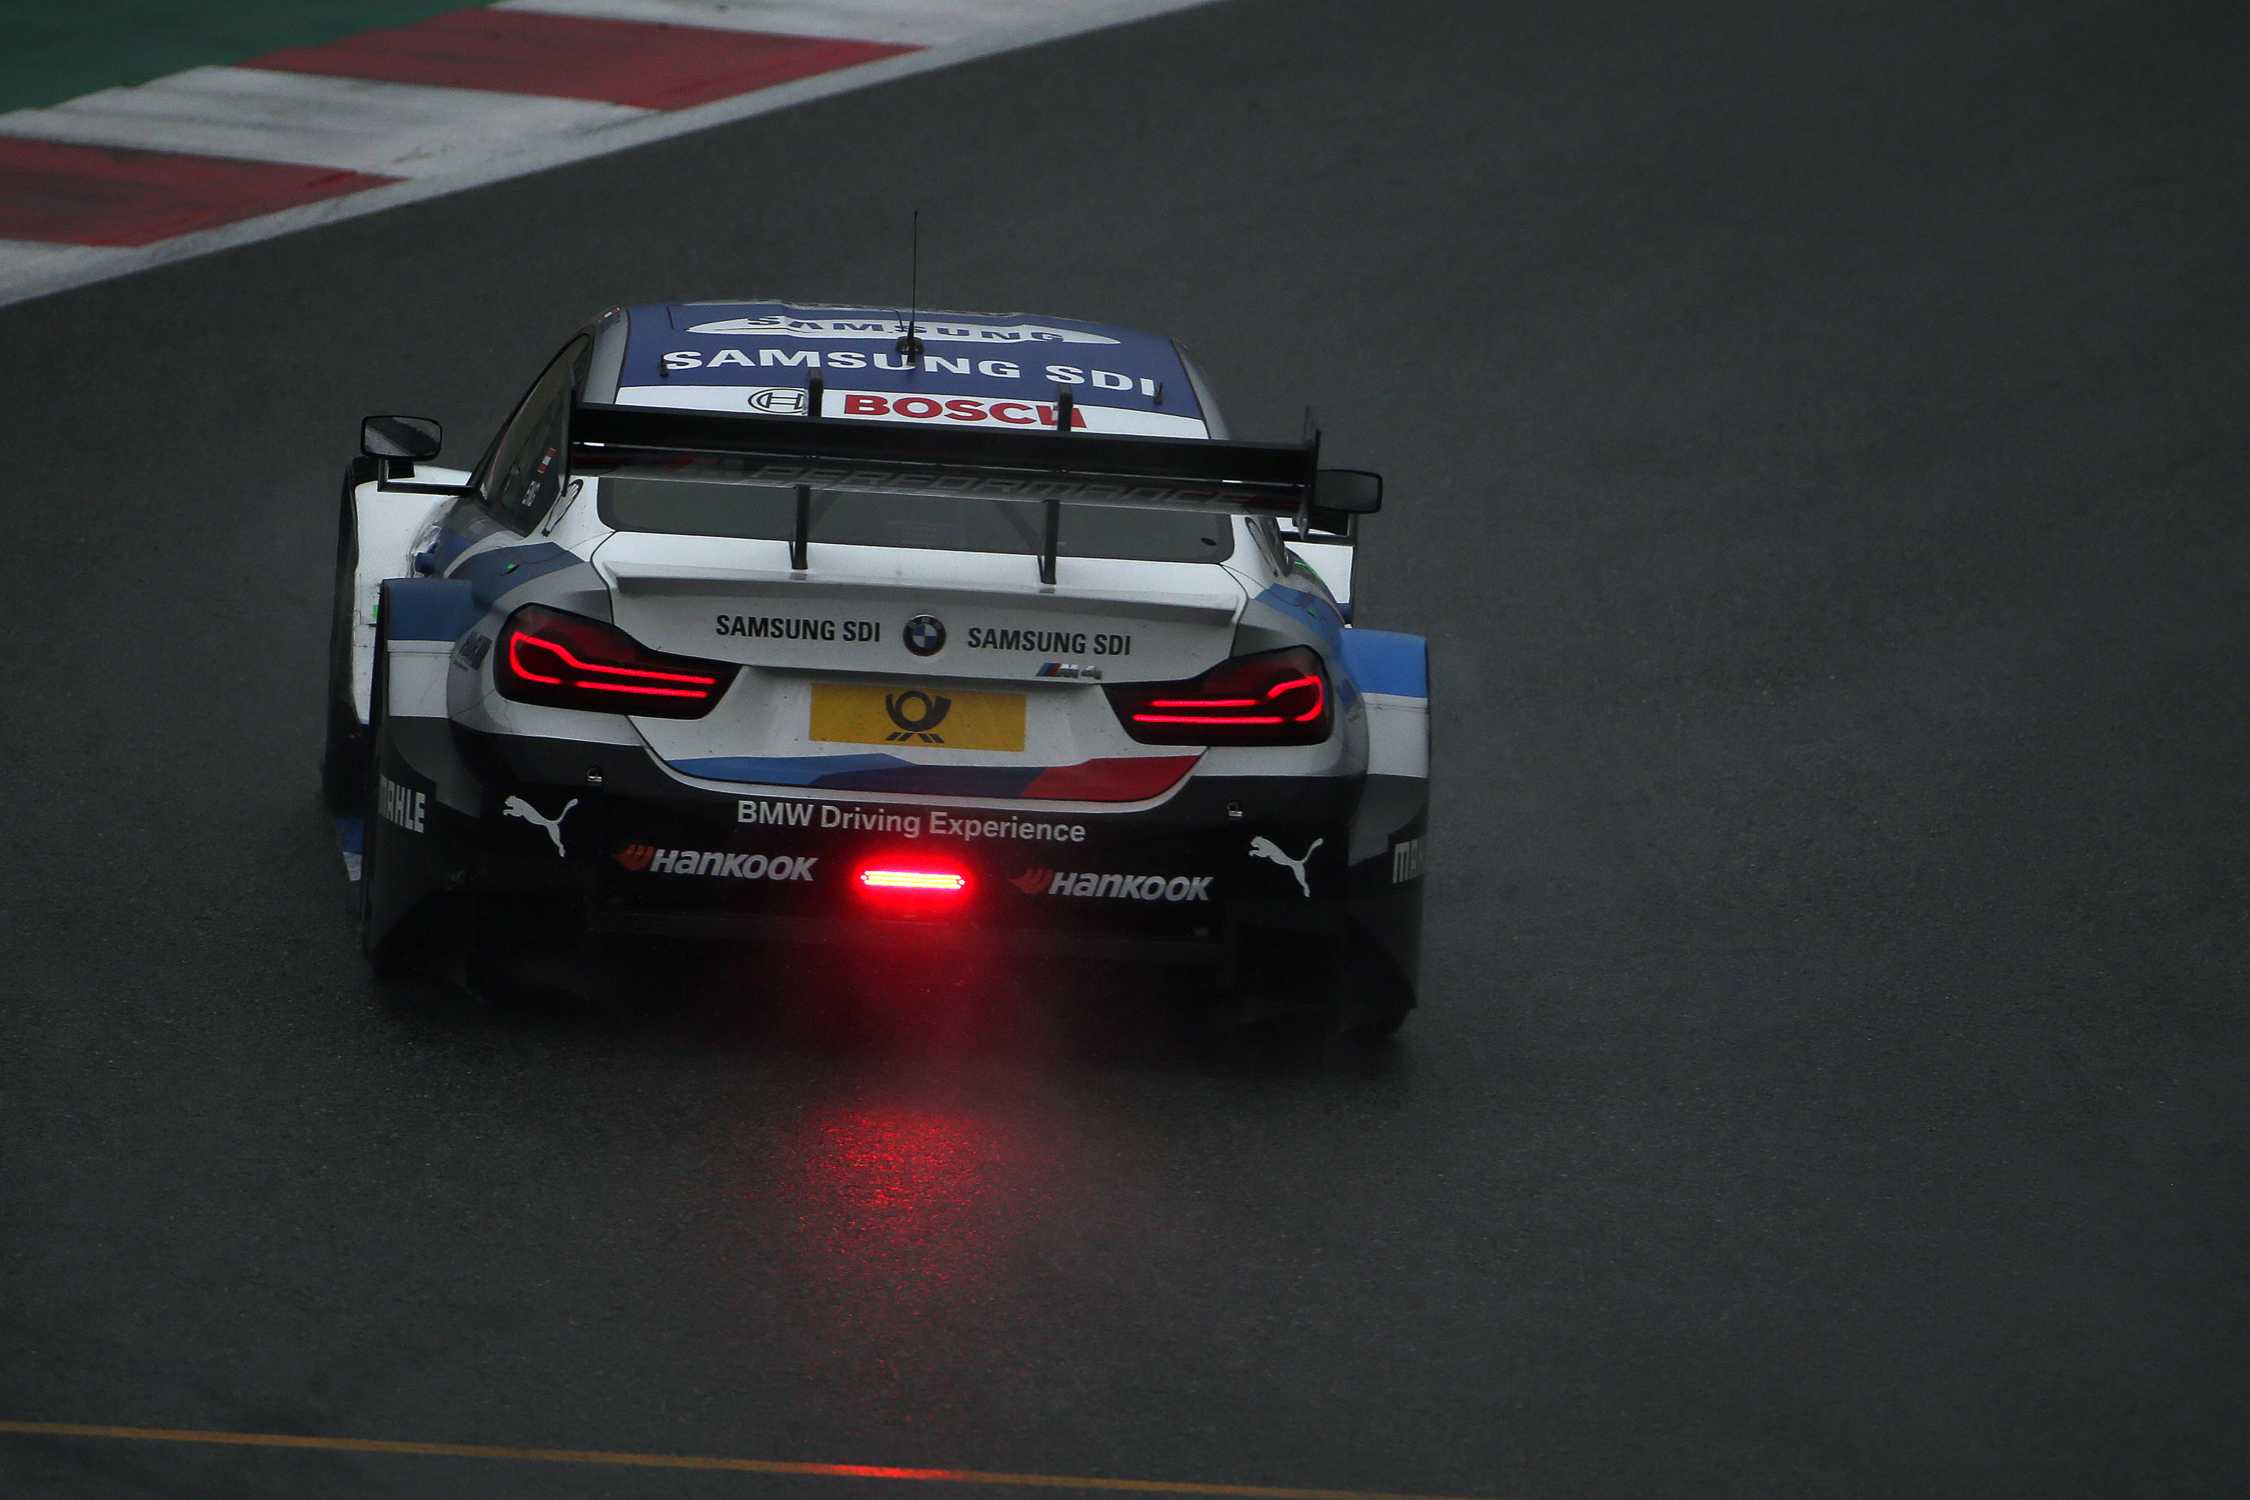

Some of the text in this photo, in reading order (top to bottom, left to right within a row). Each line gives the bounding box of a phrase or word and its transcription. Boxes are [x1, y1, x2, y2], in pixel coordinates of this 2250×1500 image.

[746, 315, 1064, 342] SAMSUNG
[662, 348, 1156, 397] SAMSUNG SDI
[843, 394, 1087, 429] BOSCH
[716, 614, 881, 642] SAMSUNG SDI
[967, 627, 1132, 655] SAMSUNG SDI
[737, 800, 1086, 842] BMW Driving Experience
